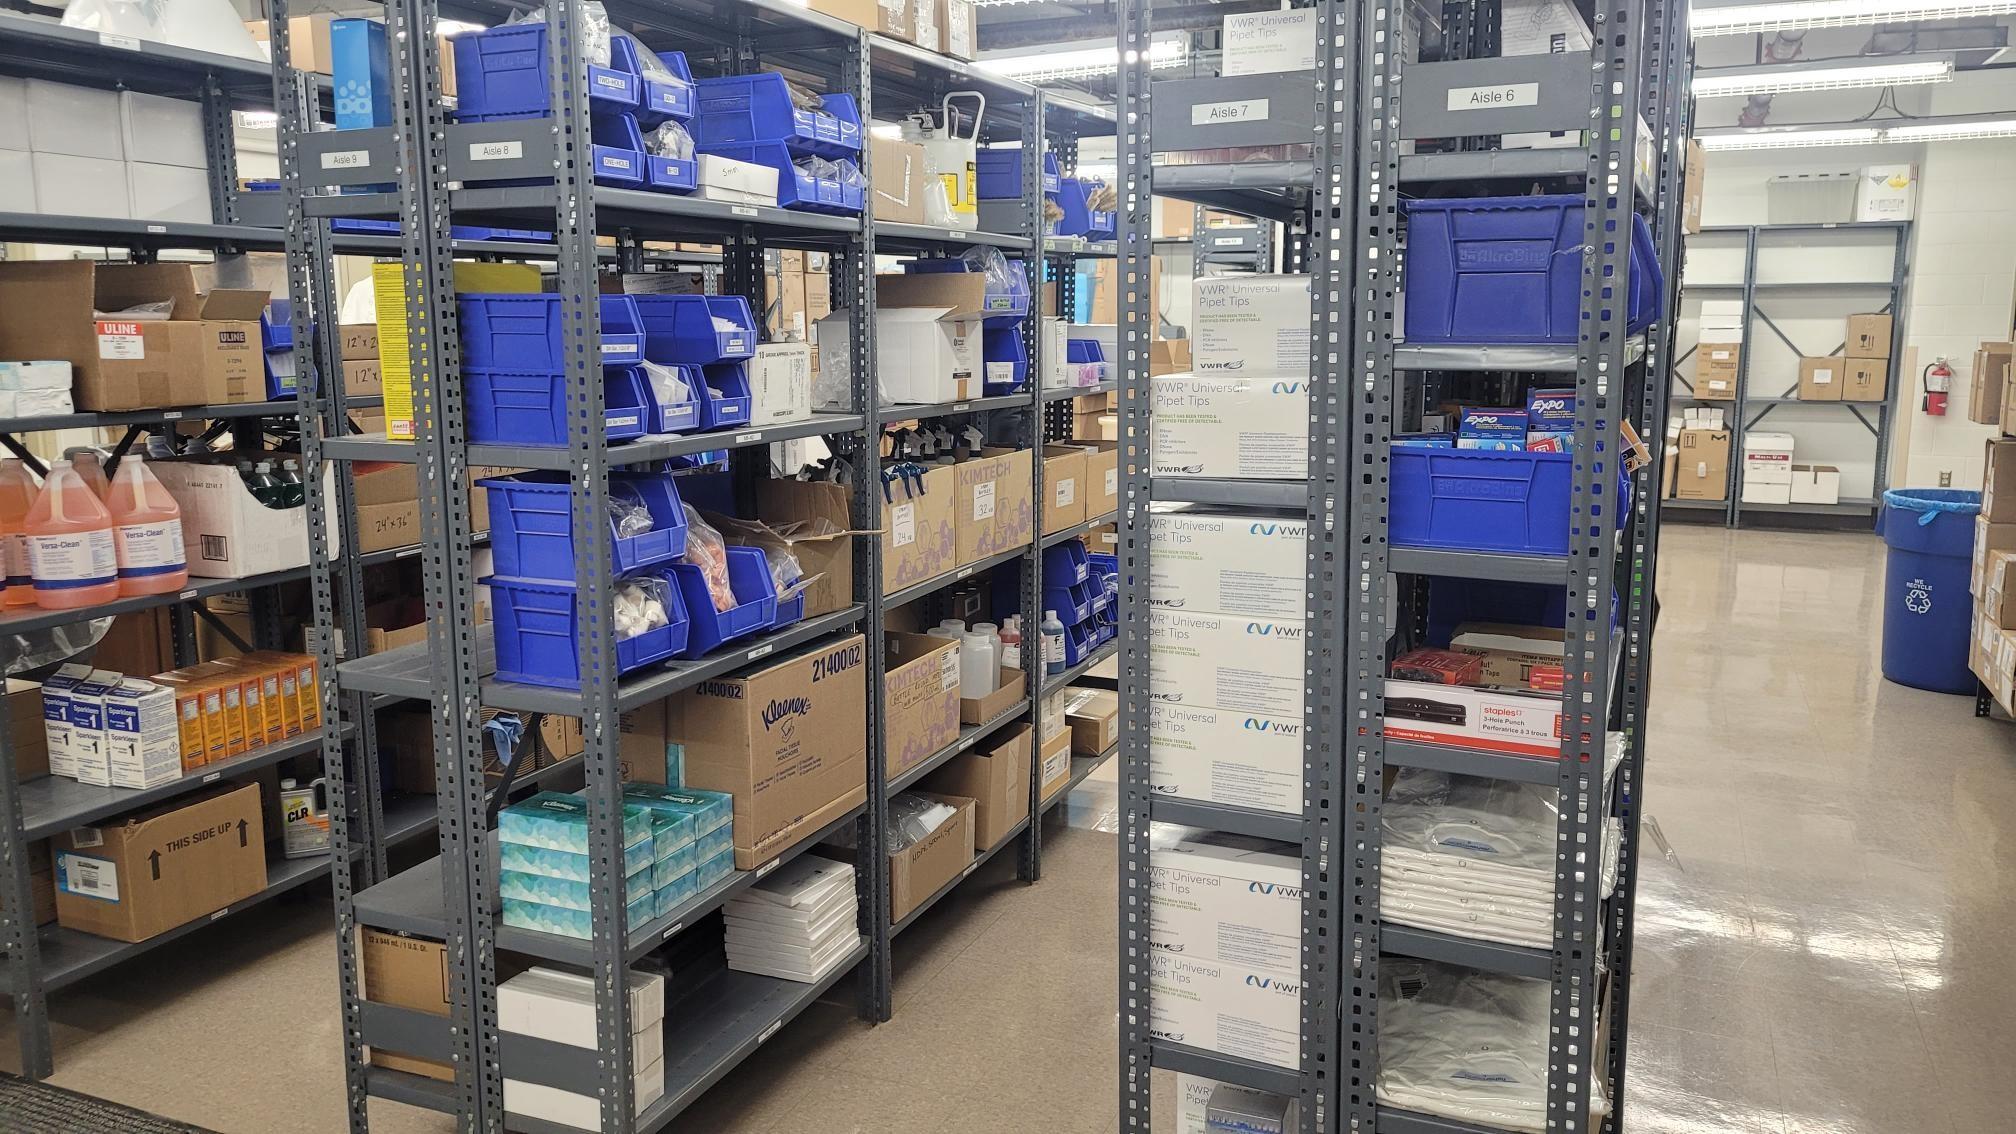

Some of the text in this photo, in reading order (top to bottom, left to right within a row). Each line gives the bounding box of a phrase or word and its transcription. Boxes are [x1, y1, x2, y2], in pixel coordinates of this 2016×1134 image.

[1261, 13, 1306, 26] Universal
[1230, 28, 1277, 41] Pipet Tips
[598, 76, 624, 87] TWO-HOLE
[1470, 89, 1514, 103] Aisle 6
[1210, 105, 1248, 119] Aisle 7
[483, 145, 509, 155] Aisle 8
[333, 155, 357, 164] Aisle 9
[605, 159, 629, 167] ONE-HOLE
[1232, 283, 1280, 294] Universal
[1200, 296, 1249, 308] Pipet Tips
[104, 323, 137, 335] ULINE
[219, 333, 245, 342] ULINE
[1191, 381, 1244, 393] Universal
[1156, 395, 1210, 407] Pipet Tips
[1530, 400, 1565, 414] EXPO
[1464, 416, 1498, 424] EXPO
[959, 460, 1011, 486] KIMTECH
[1174, 520, 1224, 532] Universal
[1279, 525, 1307, 536] vwr
[1150, 532, 1192, 544] pet Tips
[1906, 582, 1933, 591] RECYCLE
[1172, 616, 1221, 630] Universal
[1168, 628, 1190, 640] Tips
[1274, 626, 1302, 637] vwr
[886, 657, 936, 693] KIMTECH
[44, 698, 69, 706] Sparkleen
[60, 707, 67, 720] 1
[73, 705, 99, 715] Sparkleen
[108, 707, 136, 716] Sparkleen
[762, 698, 807, 731] Kleenex
[1484, 707, 1516, 717] staples
[90, 714, 96, 728] 1
[126, 716, 133, 730] 1
[1168, 710, 1217, 724] Universal
[1164, 720, 1186, 733] Tips
[1272, 722, 1300, 734] vwr
[1482, 724, 1519, 733] Perforatrice
[63, 733, 69, 746] 1
[76, 731, 101, 740] Sparkleen
[111, 734, 138, 742] Sparkleen
[92, 741, 98, 754] 1
[129, 743, 135, 756] 1
[288, 807, 309, 823] CLR
[166, 822, 232, 853] THIS SIDE UP
[1172, 872, 1221, 887] Universal
[1150, 880, 1191, 895] pet Tips
[1174, 960, 1221, 979] Universal
[1150, 969, 1191, 984] pet Tips
[1272, 981, 1300, 994] vwr
